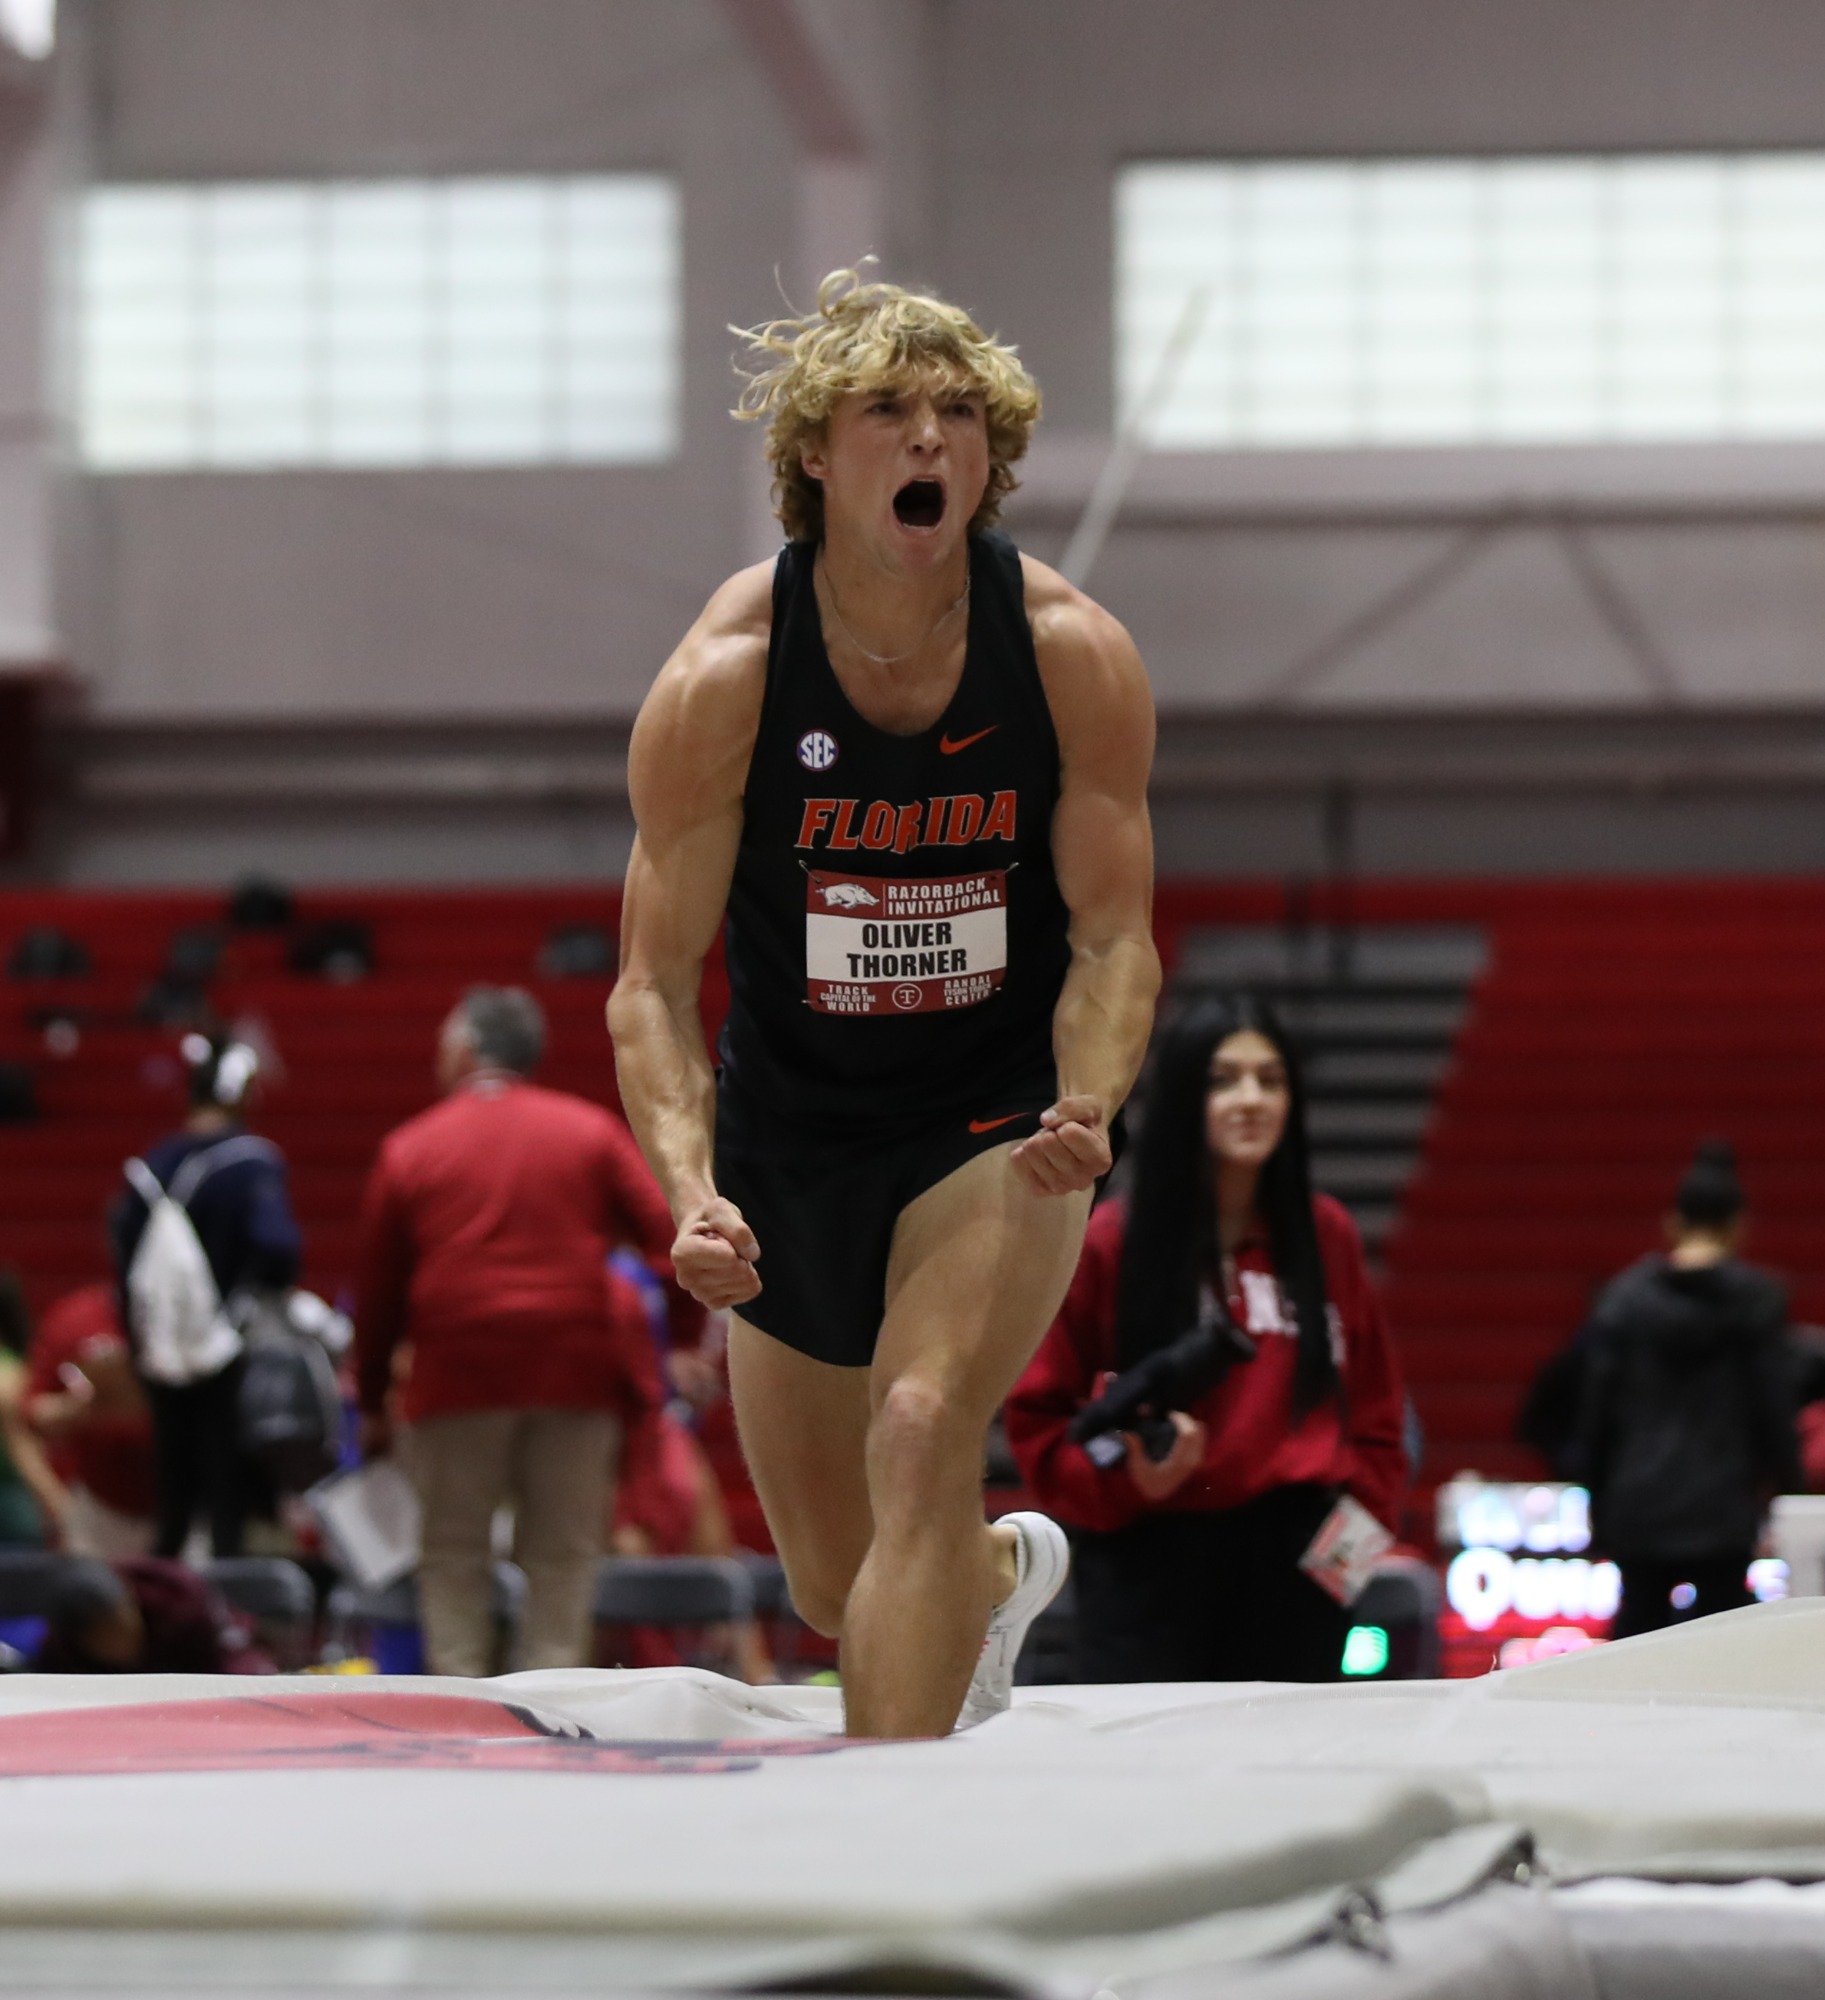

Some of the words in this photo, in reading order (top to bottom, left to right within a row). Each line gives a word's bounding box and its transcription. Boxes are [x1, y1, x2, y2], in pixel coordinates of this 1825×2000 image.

[800, 732, 836, 769] SEC
[794, 790, 1017, 855] FLORIDA
[888, 877, 986, 900] RAZORBACK
[888, 889, 1001, 915] INVITATIONAL
[862, 921, 952, 949] OLIVER
[846, 948, 968, 978] THORNER
[827, 984, 869, 995] TRACK
[945, 989, 990, 1006] CENTER
[827, 1001, 870, 1012] WORLD
